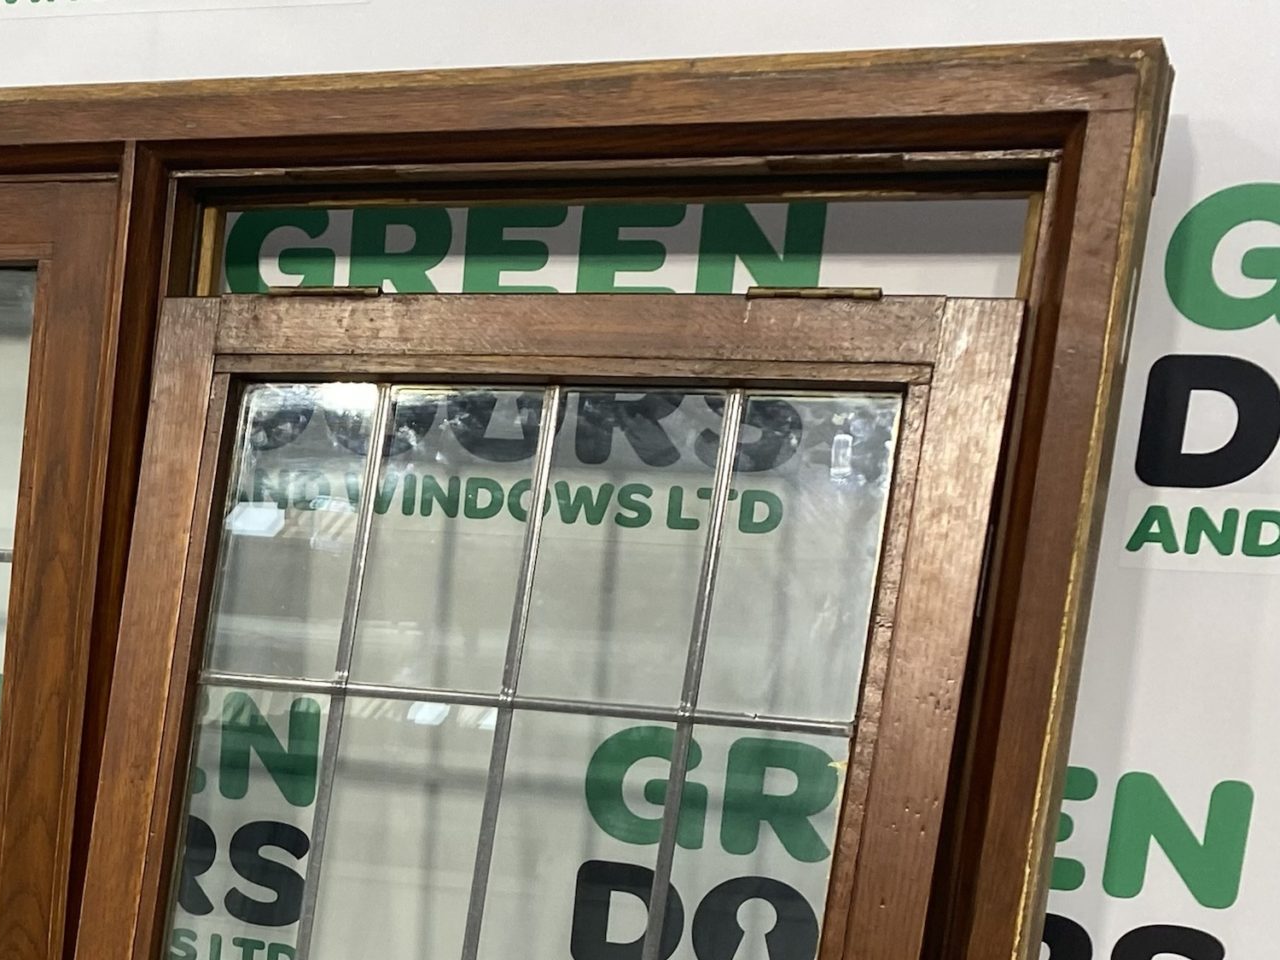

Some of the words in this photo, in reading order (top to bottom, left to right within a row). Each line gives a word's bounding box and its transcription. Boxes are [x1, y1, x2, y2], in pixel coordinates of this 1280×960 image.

[225, 202, 829, 295] GREEN
[344, 472, 653, 528] WINDOWS
[1125, 505, 1280, 557] AND
